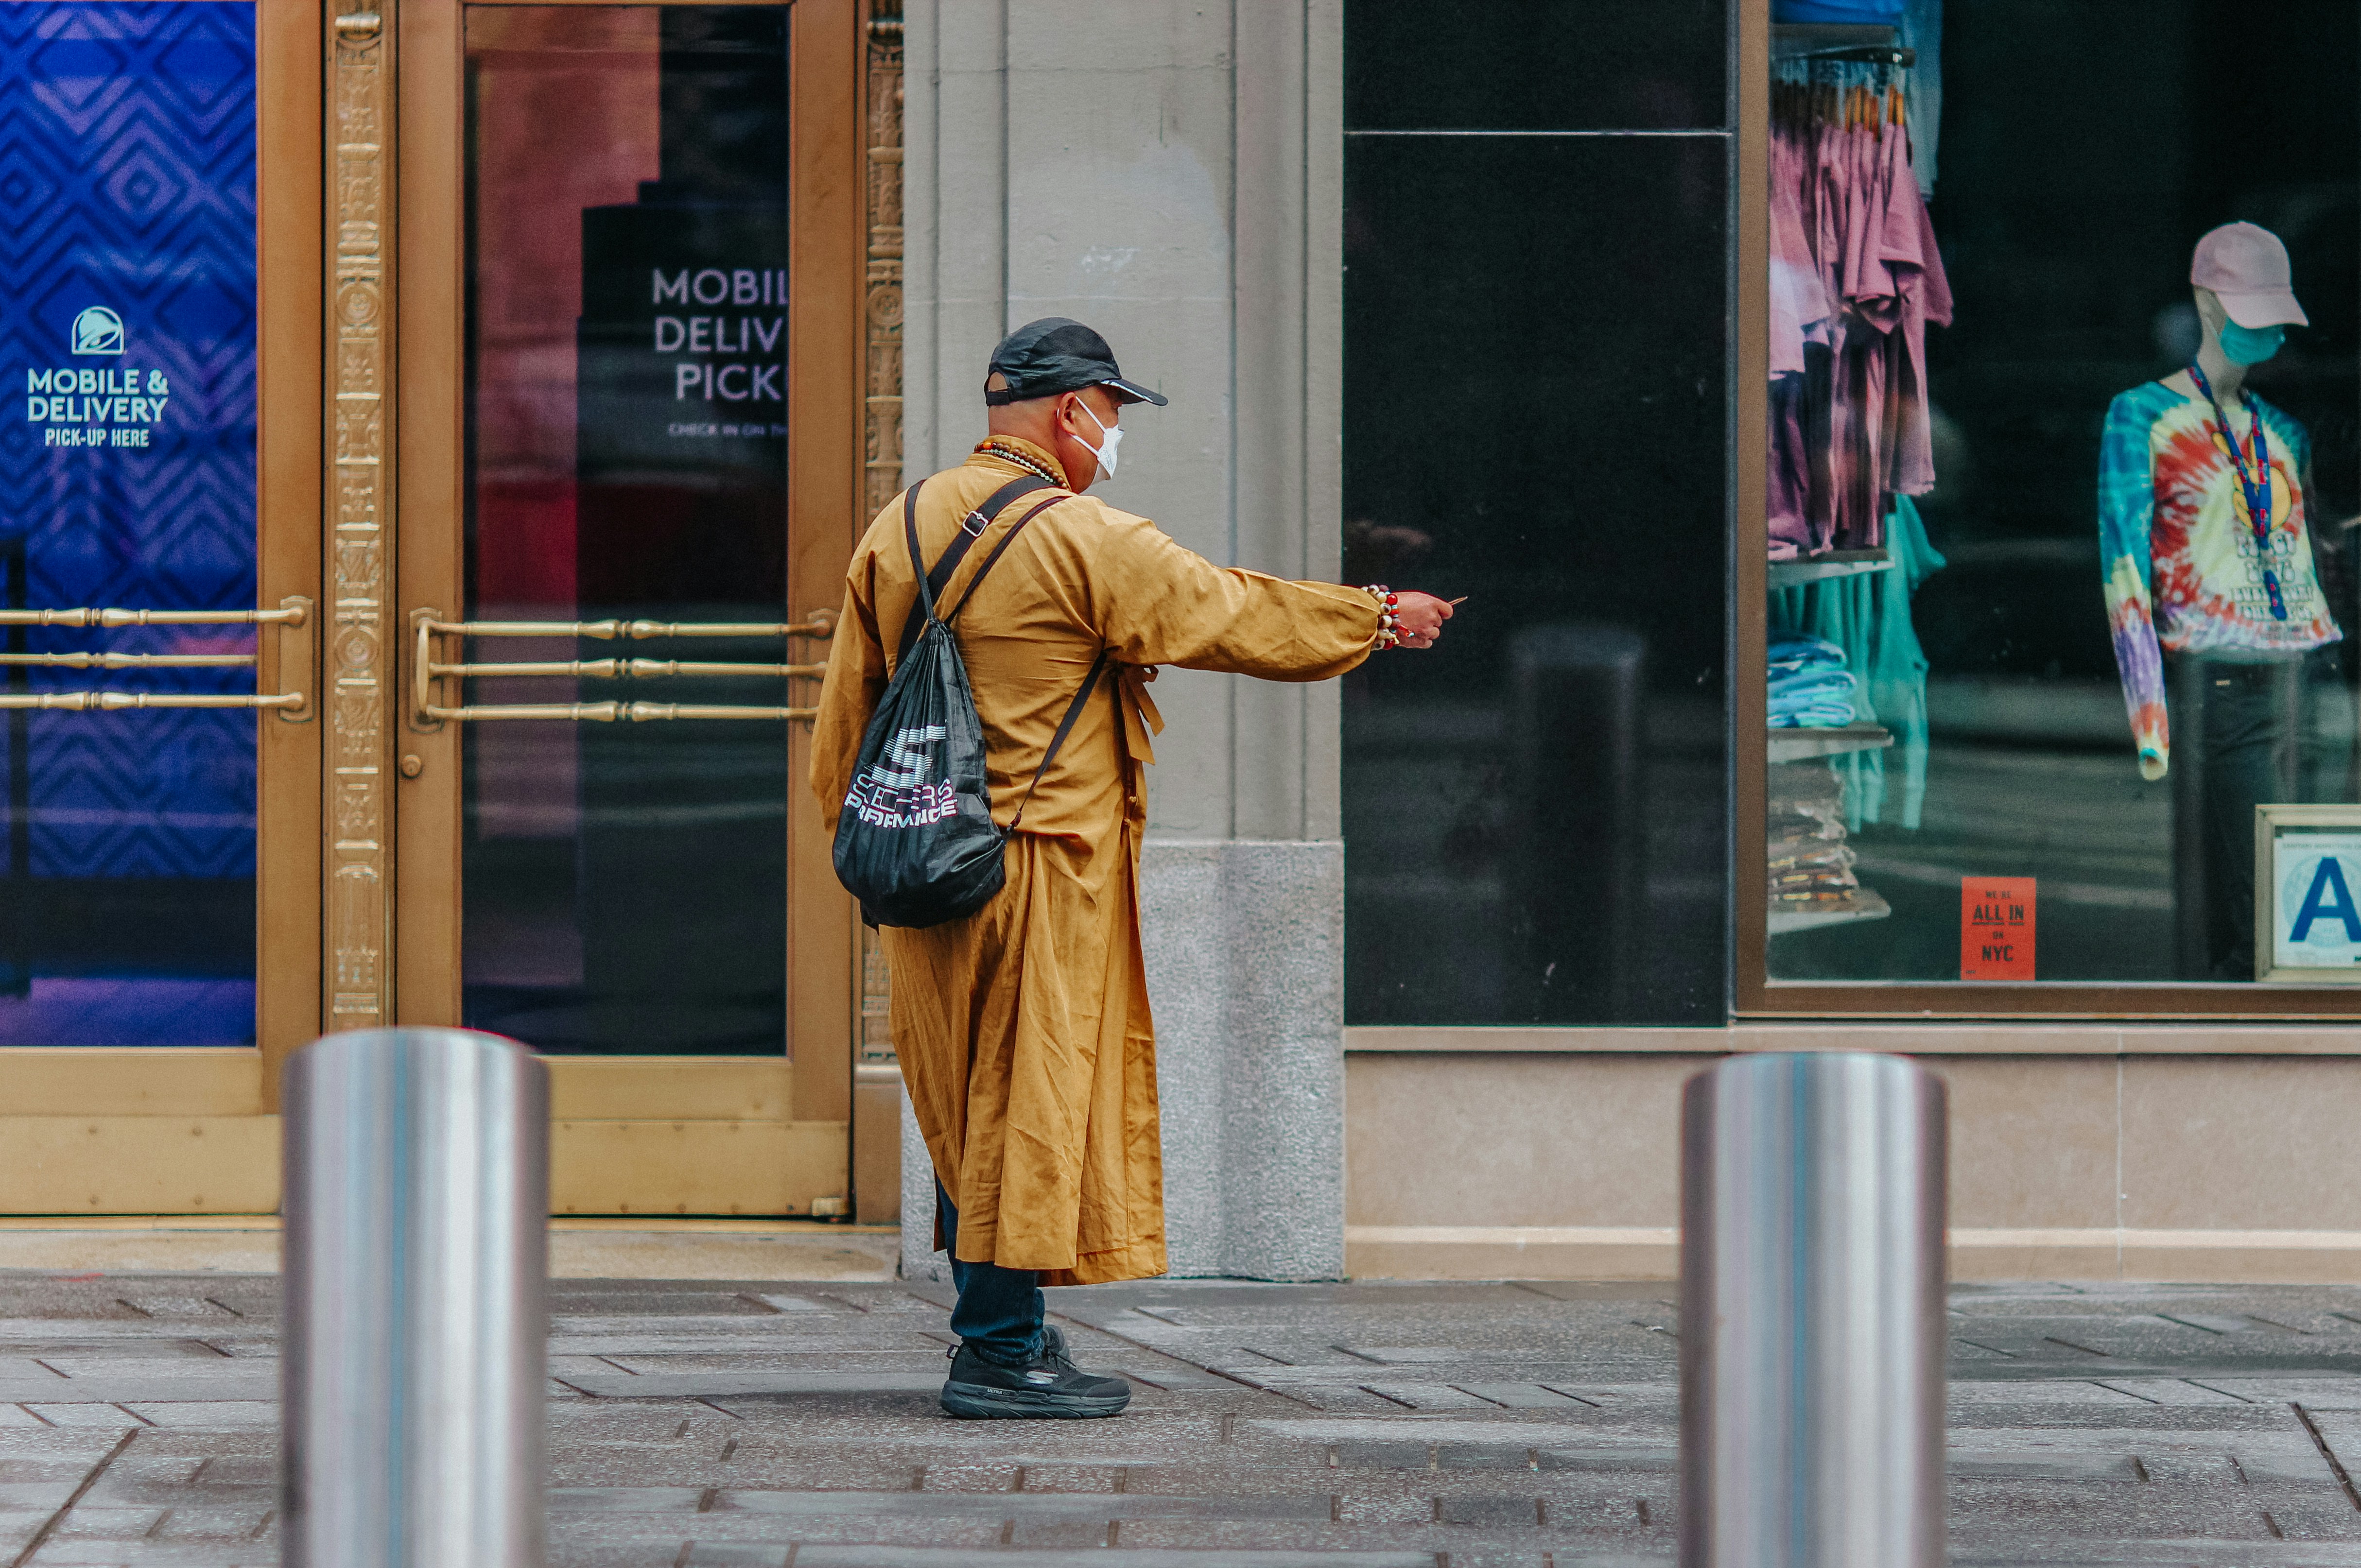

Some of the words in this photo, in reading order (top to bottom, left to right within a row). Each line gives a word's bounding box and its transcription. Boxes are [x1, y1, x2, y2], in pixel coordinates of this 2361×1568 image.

[28, 368, 139, 395] MOBILE
[147, 369, 169, 395] &
[677, 363, 788, 400] PICK
[28, 396, 168, 423] DELIVERY
[45, 428, 106, 447] PICK-UP
[111, 429, 149, 447] HERE
[1973, 904, 2004, 920] ALL
[2009, 905, 2024, 920] IN
[2289, 857, 2361, 943] A
[1981, 945, 2014, 962] NYC
